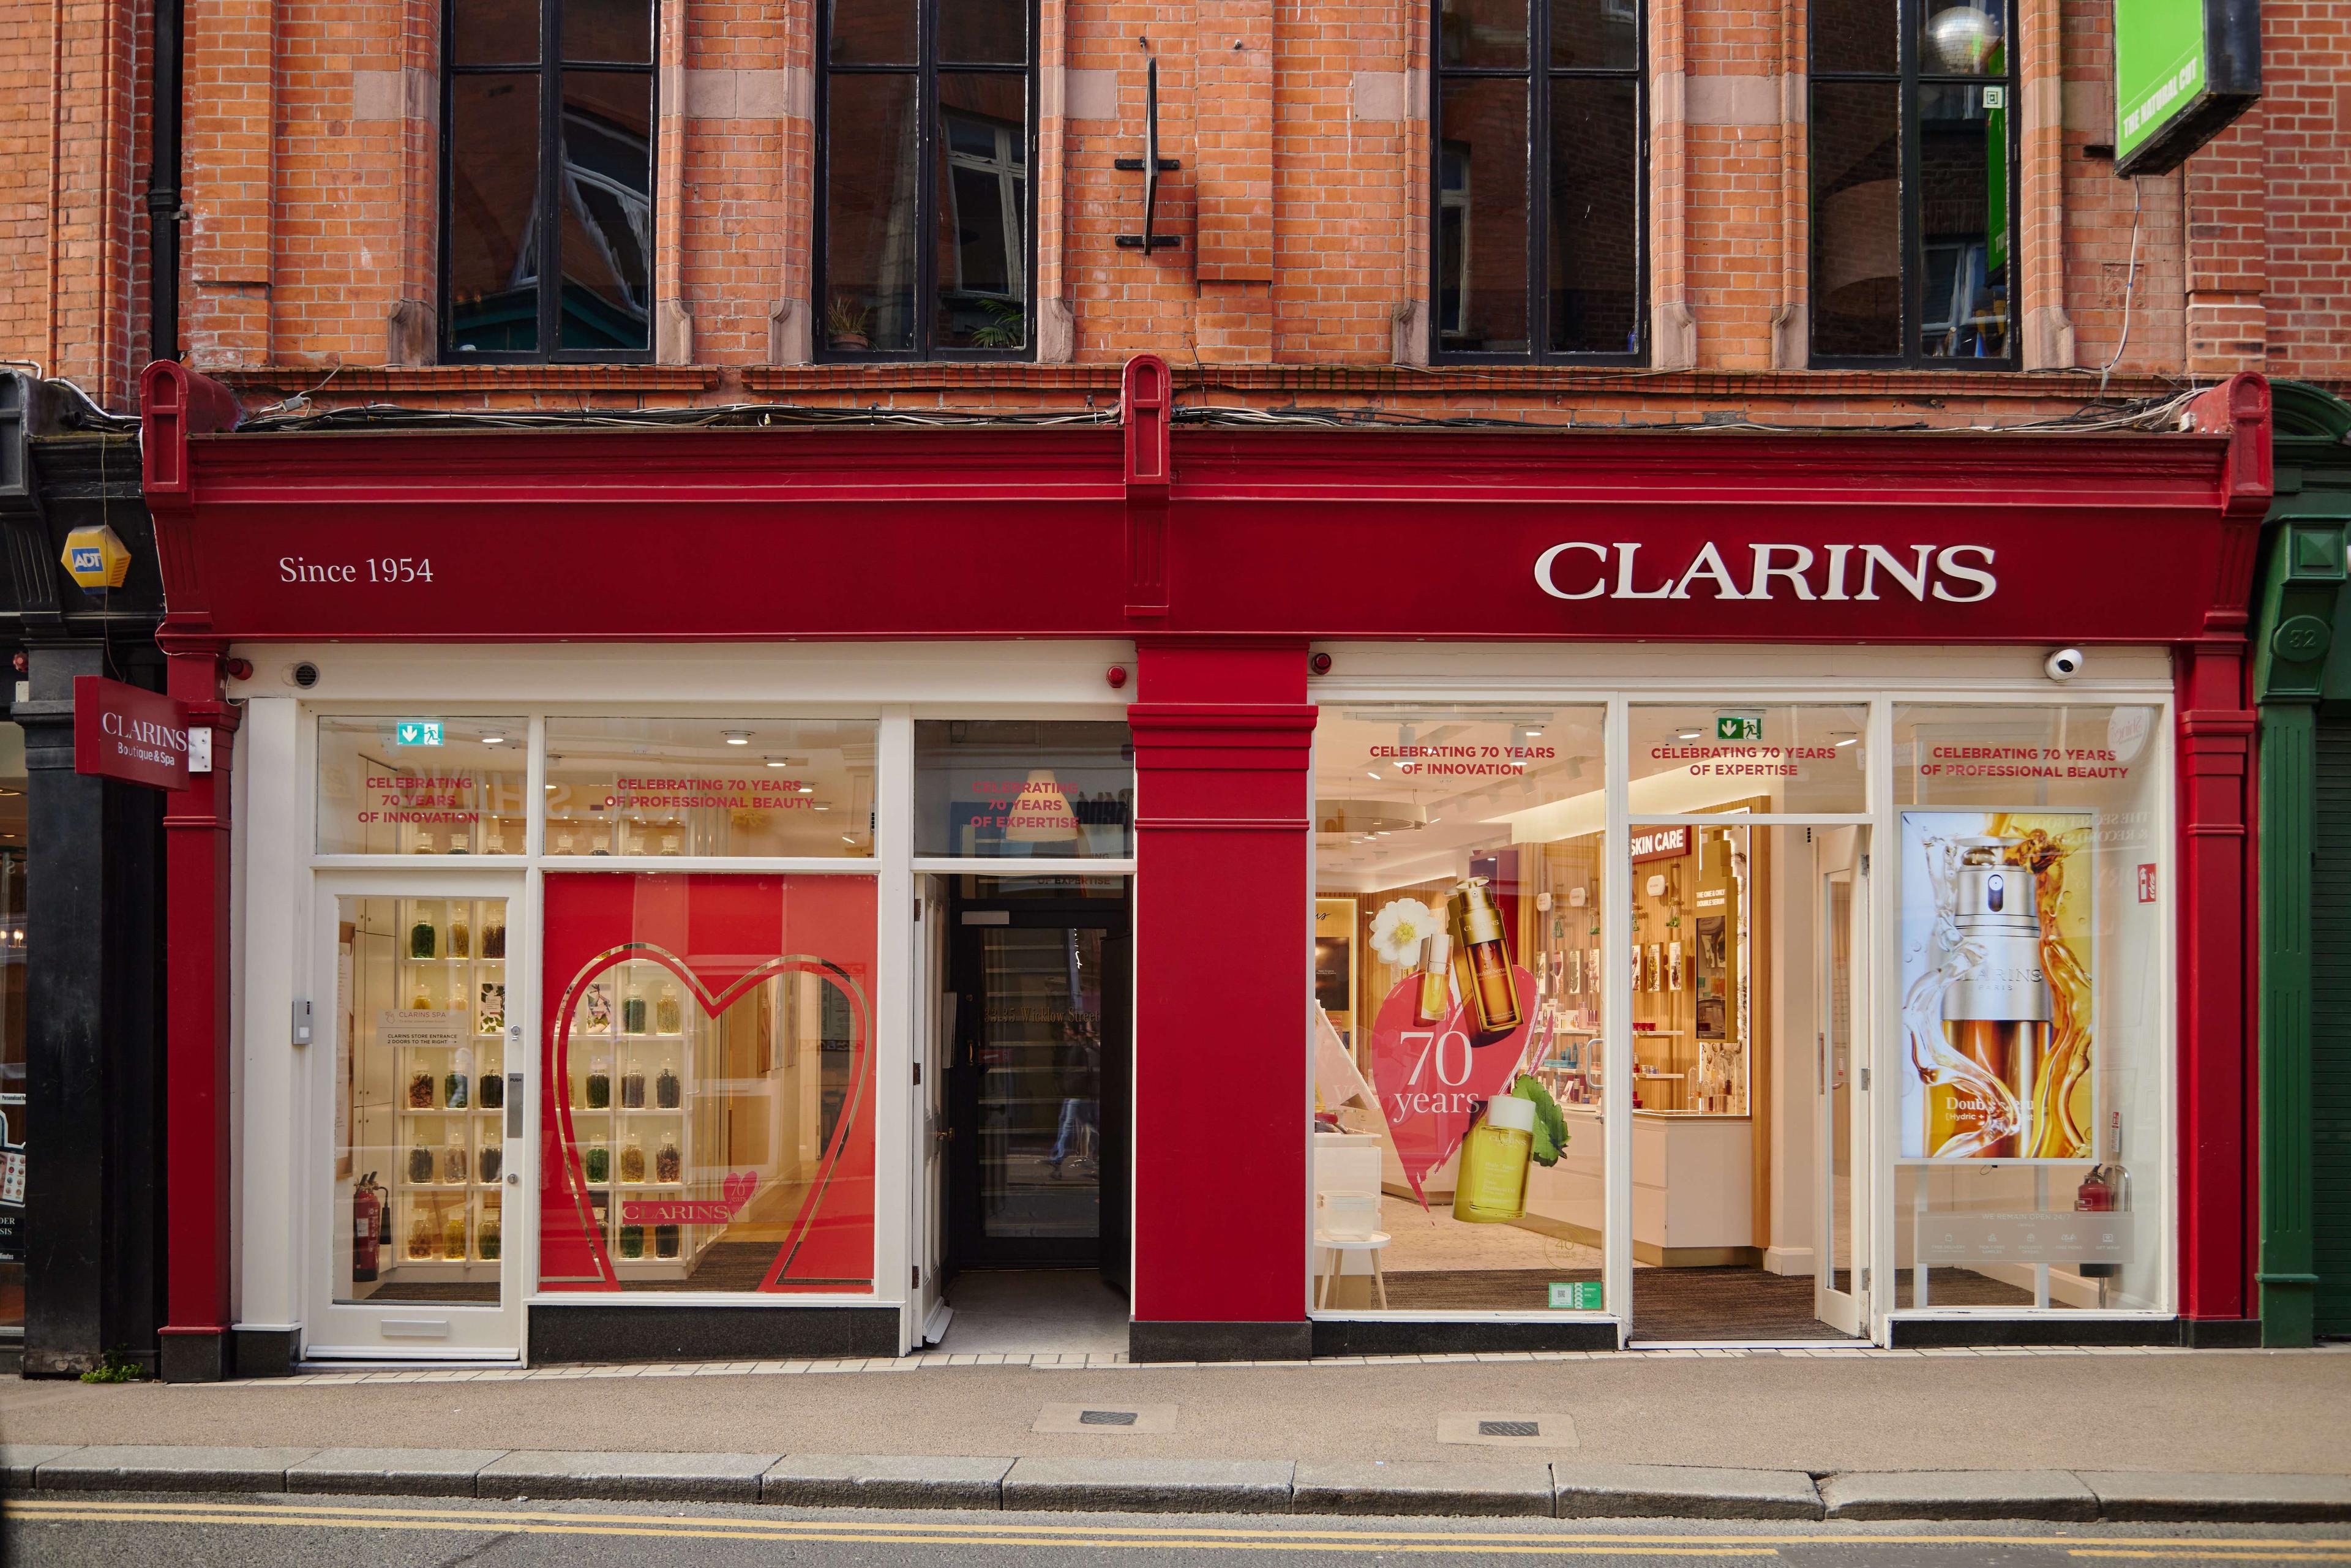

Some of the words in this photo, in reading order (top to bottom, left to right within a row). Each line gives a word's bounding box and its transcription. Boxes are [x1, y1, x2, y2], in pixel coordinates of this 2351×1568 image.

[2123, 108, 2140, 138] THE
[2140, 75, 2178, 124] NATURAL
[2179, 56, 2197, 91] CUT
[75, 553, 100, 568] ADT
[279, 557, 357, 582] Since
[366, 557, 434, 582] 1954
[1534, 542, 1997, 602] CLARINS
[102, 711, 187, 752] CLARINS
[118, 741, 153, 761] Boutique
[160, 751, 175, 767] Spa
[1370, 746, 1476, 758] CELEBRATING
[1480, 746, 1499, 758] 70
[1503, 746, 1556, 759] YEARS
[1651, 747, 1757, 759] CELEBRATING
[1762, 747, 1780, 759] 70
[1784, 748, 1836, 759] YEARS
[1932, 746, 2038, 760] CELEBRATING
[2042, 748, 2061, 760] 70
[2066, 749, 2117, 761] YEARS
[1401, 763, 1423, 776] OF
[1427, 763, 1524, 776] INNOVATION
[1689, 764, 1710, 776] OF
[1715, 764, 1798, 776] EXPERTISE
[1920, 763, 1941, 776] OF
[1945, 764, 2063, 778] PROFESSIONAL
[2067, 766, 2129, 779] BEAUTY
[366, 777, 472, 789] CELEBRATING
[617, 778, 724, 791] CELEBRATING
[729, 779, 746, 791] 70
[752, 779, 803, 792] YEARS
[972, 781, 1078, 794] CELEBRATING
[381, 795, 400, 806] 70
[406, 794, 456, 806] YEARS
[604, 795, 625, 808] OF
[629, 796, 748, 809] PROFESSIONAL
[753, 797, 815, 809] BEAUTY
[988, 798, 1007, 811] 70
[1011, 799, 1062, 811] YEARS
[358, 811, 379, 823] OF
[383, 811, 479, 824] INNOVATION
[970, 816, 992, 828] OF
[996, 816, 1079, 828] EXPERTISE
[1632, 835, 1653, 857] SKIN
[1654, 828, 1684, 852] CARE
[1019, 1006, 1065, 1024] Wicklow
[1068, 1007, 1100, 1023] Street
[1400, 1030, 1473, 1086] 70
[1393, 1090, 1480, 1123] years
[730, 1183, 746, 1196] 70
[622, 1205, 727, 1220] CLARINS
